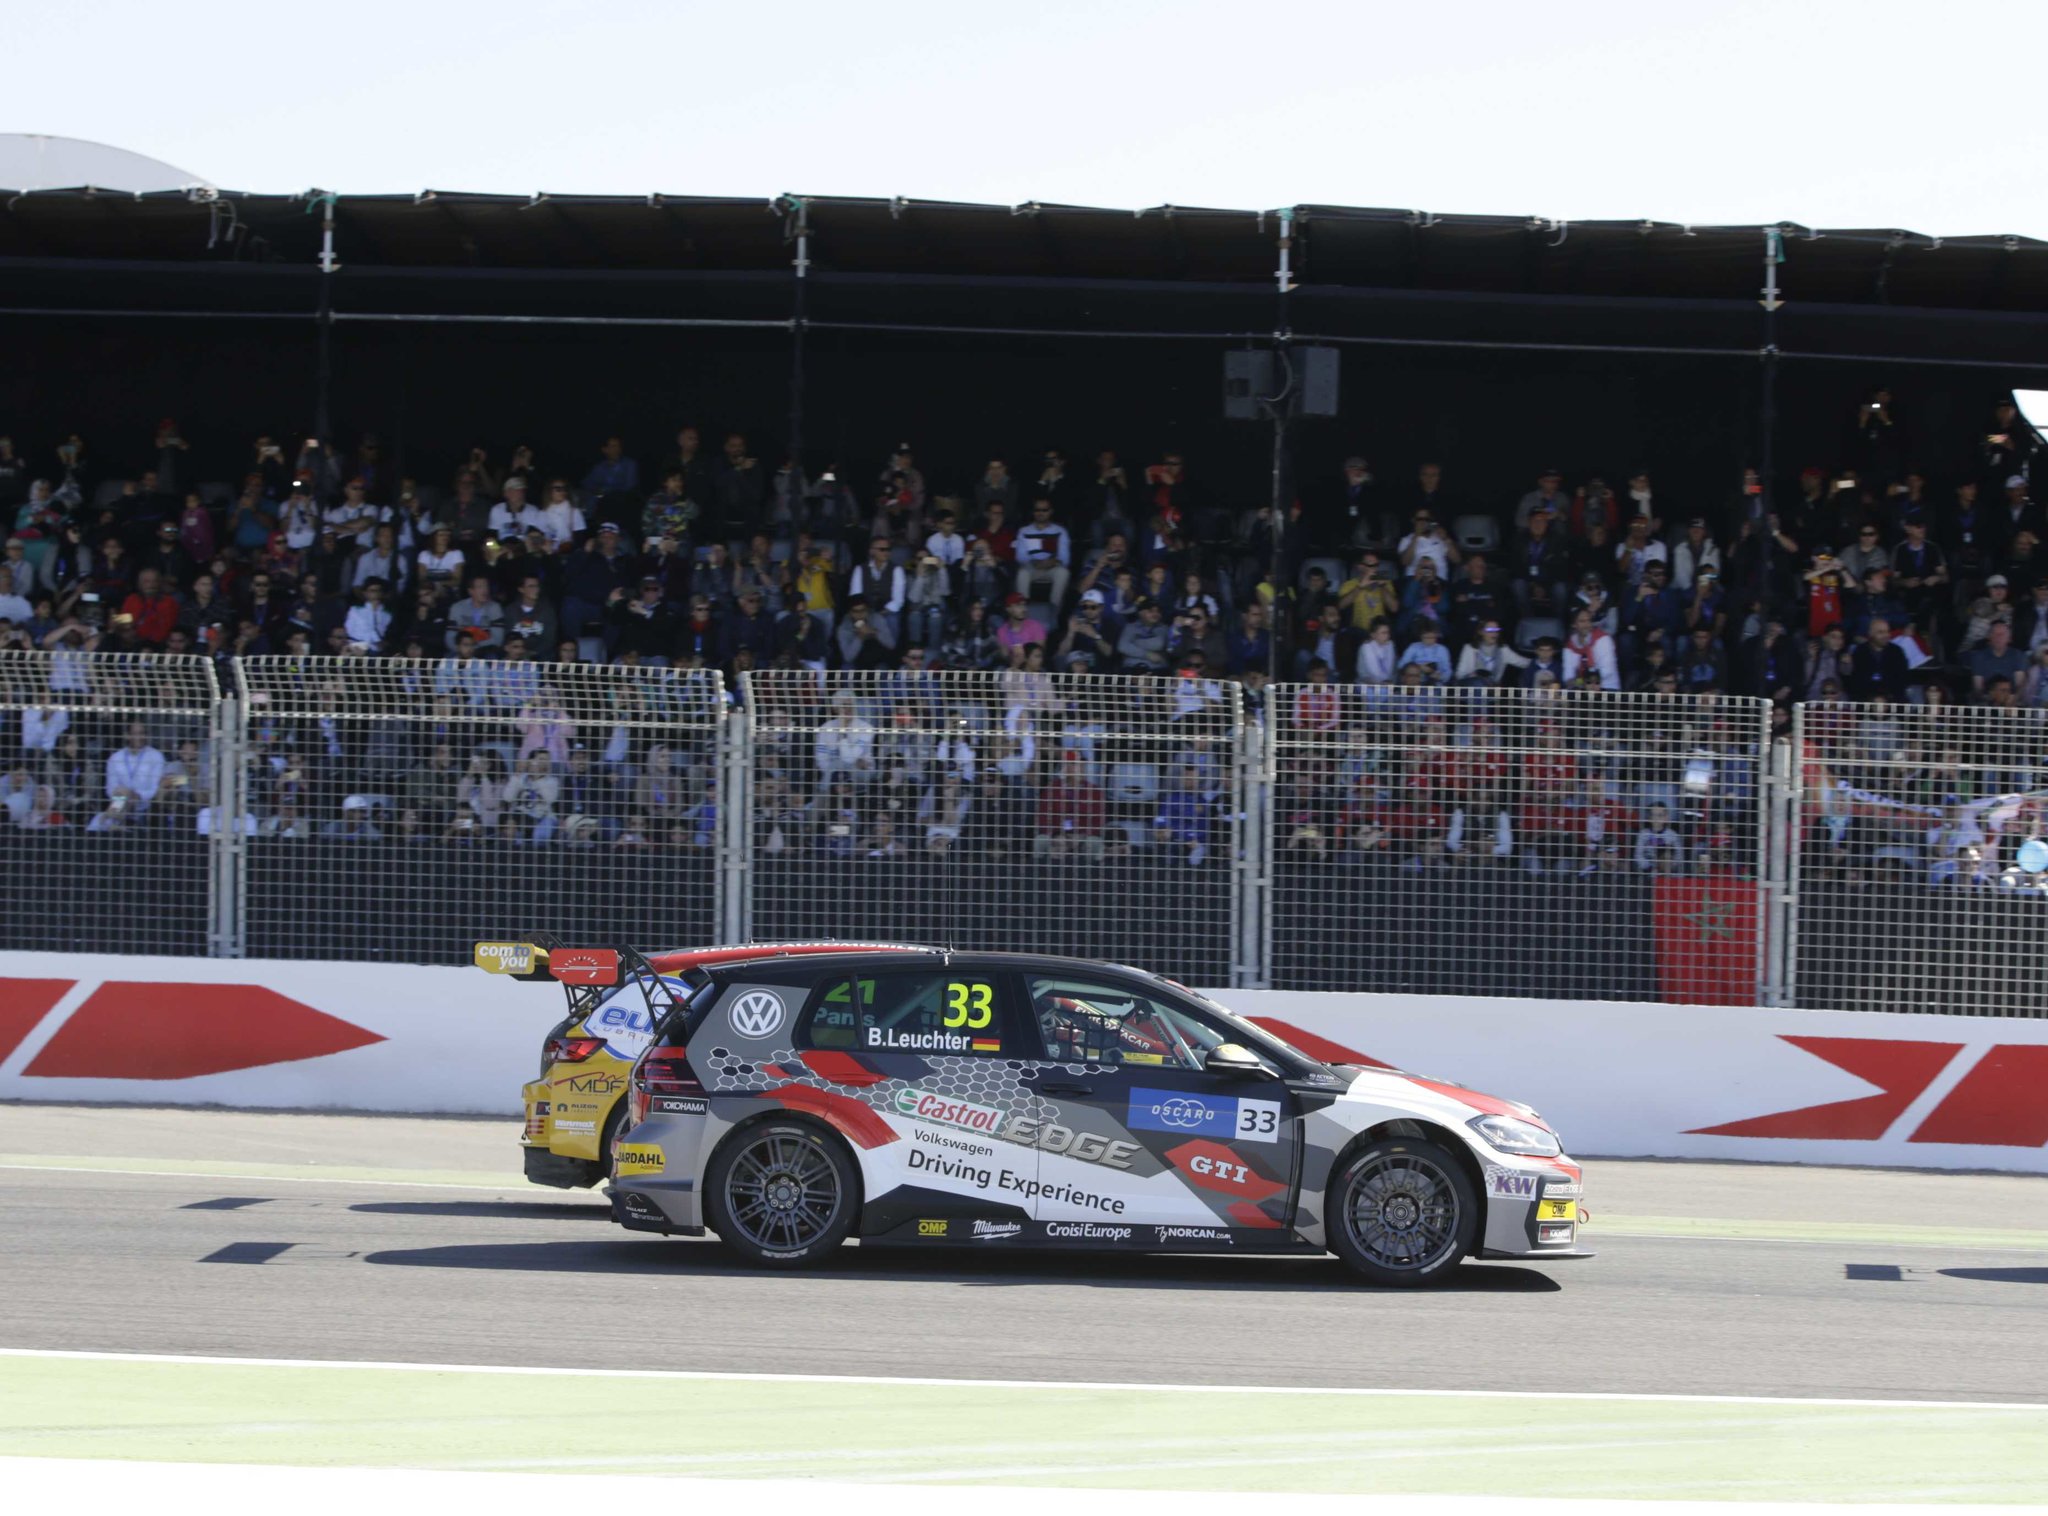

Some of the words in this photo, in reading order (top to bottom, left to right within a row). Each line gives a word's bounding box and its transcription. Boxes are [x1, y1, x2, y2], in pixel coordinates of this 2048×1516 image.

[499, 955, 529, 970] you
[943, 983, 993, 1029] 33
[868, 1027, 971, 1050] B.Leuchter
[569, 1079, 625, 1093] MDF
[662, 1101, 706, 1112] YOKOHAMA
[1151, 1105, 1215, 1120] OSCARO
[1239, 1108, 1277, 1134] 33
[917, 1095, 999, 1132] Castrol
[1001, 1115, 1144, 1169] EDGE
[914, 1129, 994, 1157] Volkswagen
[1190, 1156, 1249, 1183] GTI
[908, 1149, 992, 1189] Driving
[998, 1169, 1126, 1215] Experience
[1495, 1175, 1536, 1195] KW
[1552, 1205, 1566, 1214] OMP
[918, 1222, 948, 1233] OMP
[972, 1219, 1022, 1234] Milwaukee
[1046, 1222, 1132, 1242] CroisiEurope
